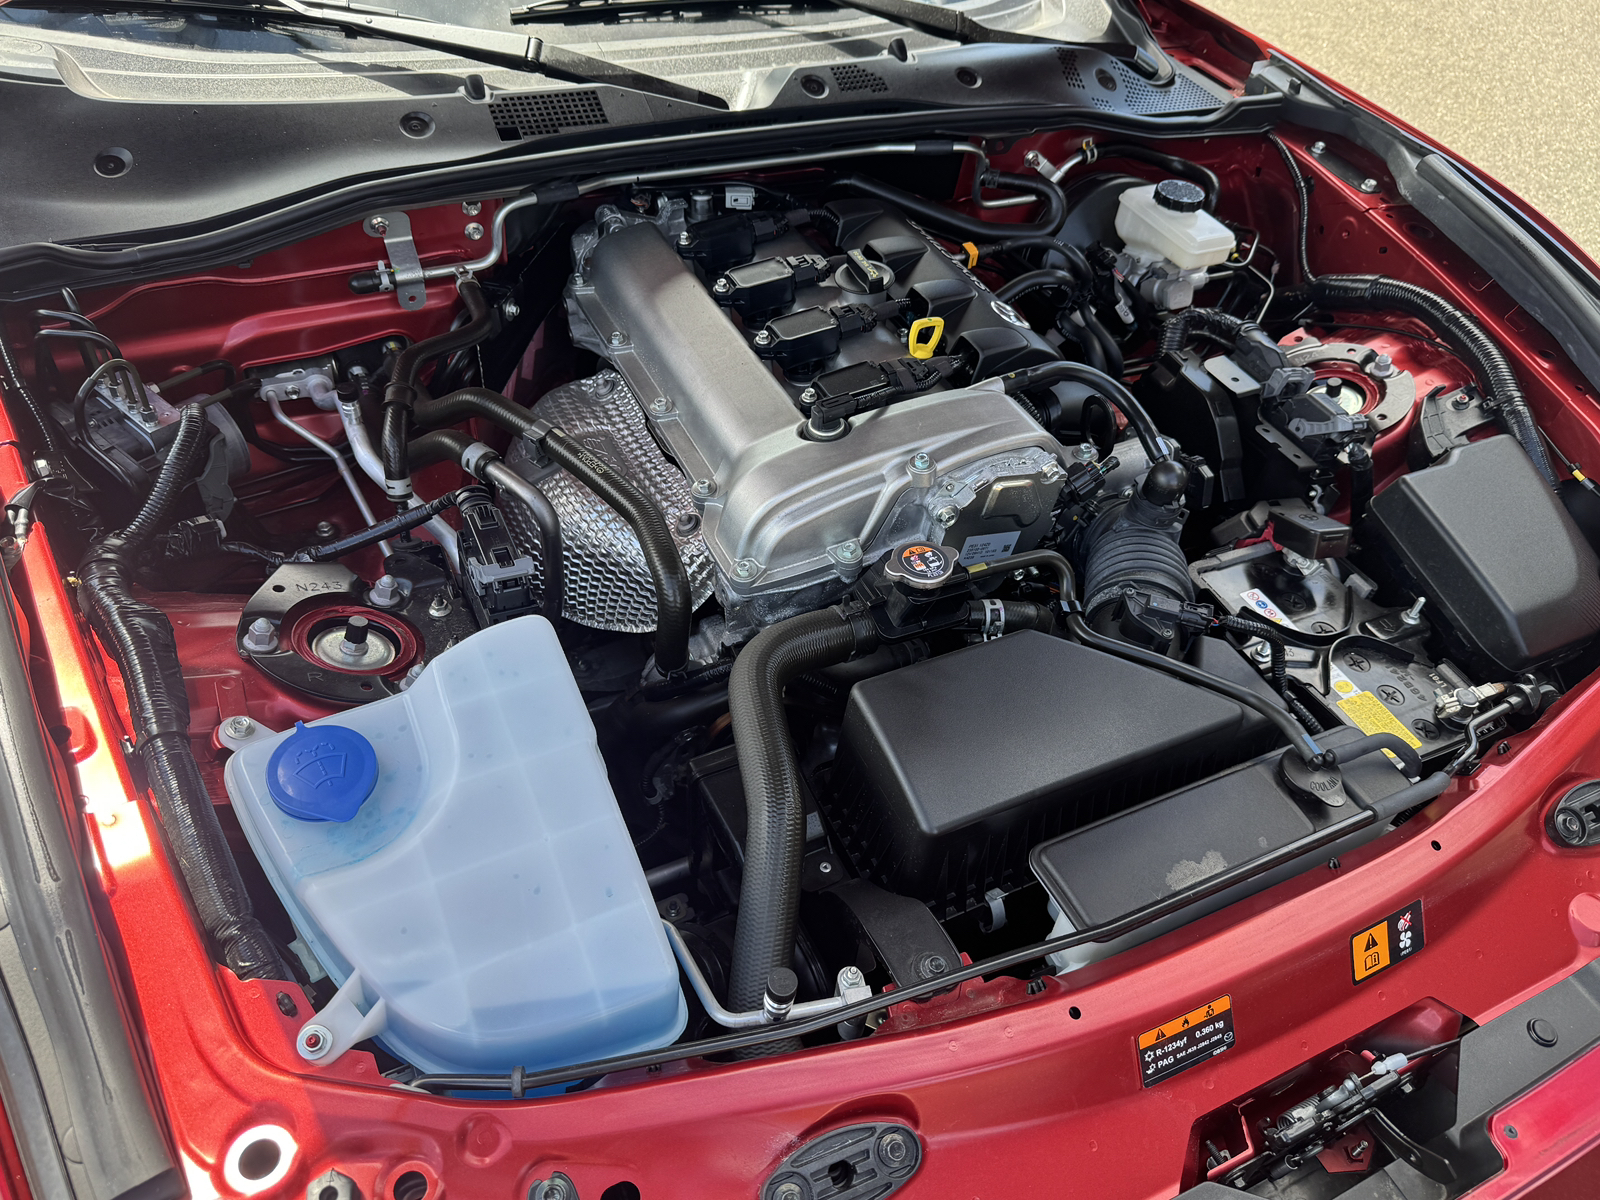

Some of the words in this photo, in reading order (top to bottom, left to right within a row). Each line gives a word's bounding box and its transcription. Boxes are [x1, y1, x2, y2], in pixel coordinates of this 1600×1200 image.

[295, 581, 343, 592] N243
[307, 672, 323, 682] R
[1310, 776, 1339, 792] COOLANT
[1155, 1036, 1187, 1057] R-1234yf
[1195, 1024, 1214, 1038] 0.360
[1214, 1020, 1224, 1030] kg
[1157, 1055, 1174, 1068] PAG
[1176, 1050, 1186, 1059] SAE
